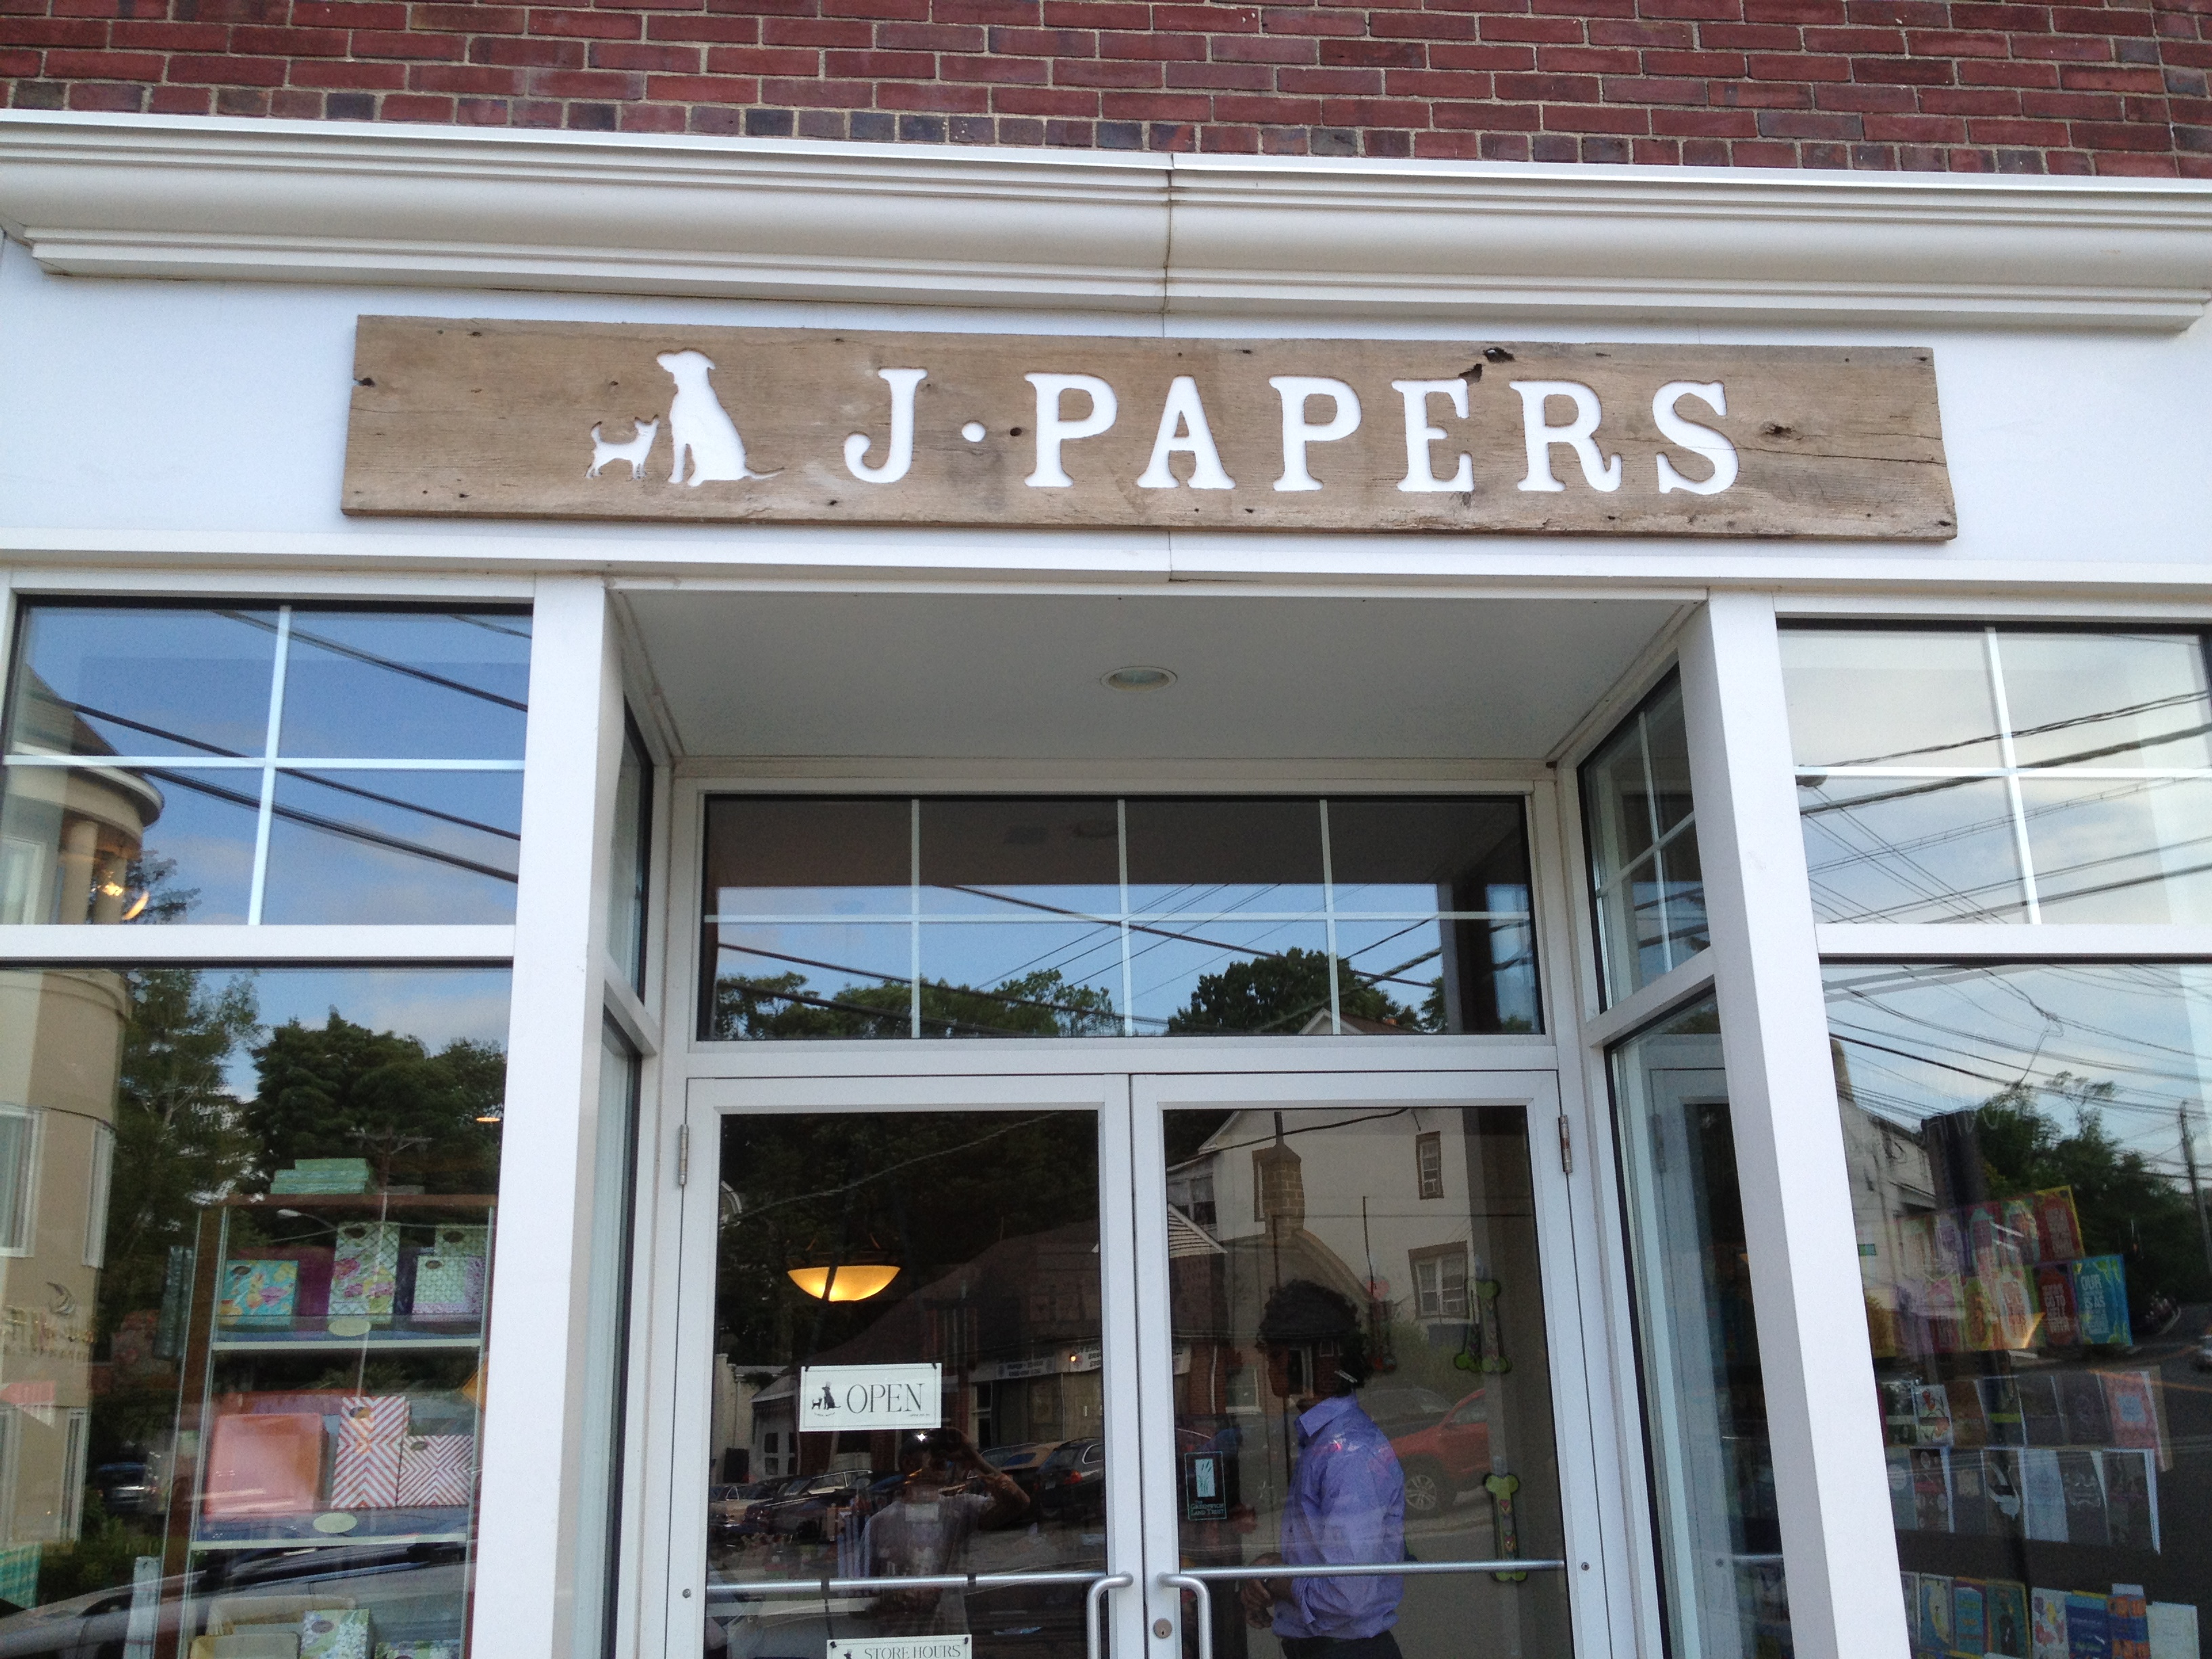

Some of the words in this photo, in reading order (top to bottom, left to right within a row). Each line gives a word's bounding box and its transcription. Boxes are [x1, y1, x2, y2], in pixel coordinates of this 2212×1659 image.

[1023, 372, 1740, 496] PAPERS
[846, 1382, 925, 1414] OPEN
[864, 1647, 909, 1659] STORE
[914, 1645, 961, 1659] HOURS
